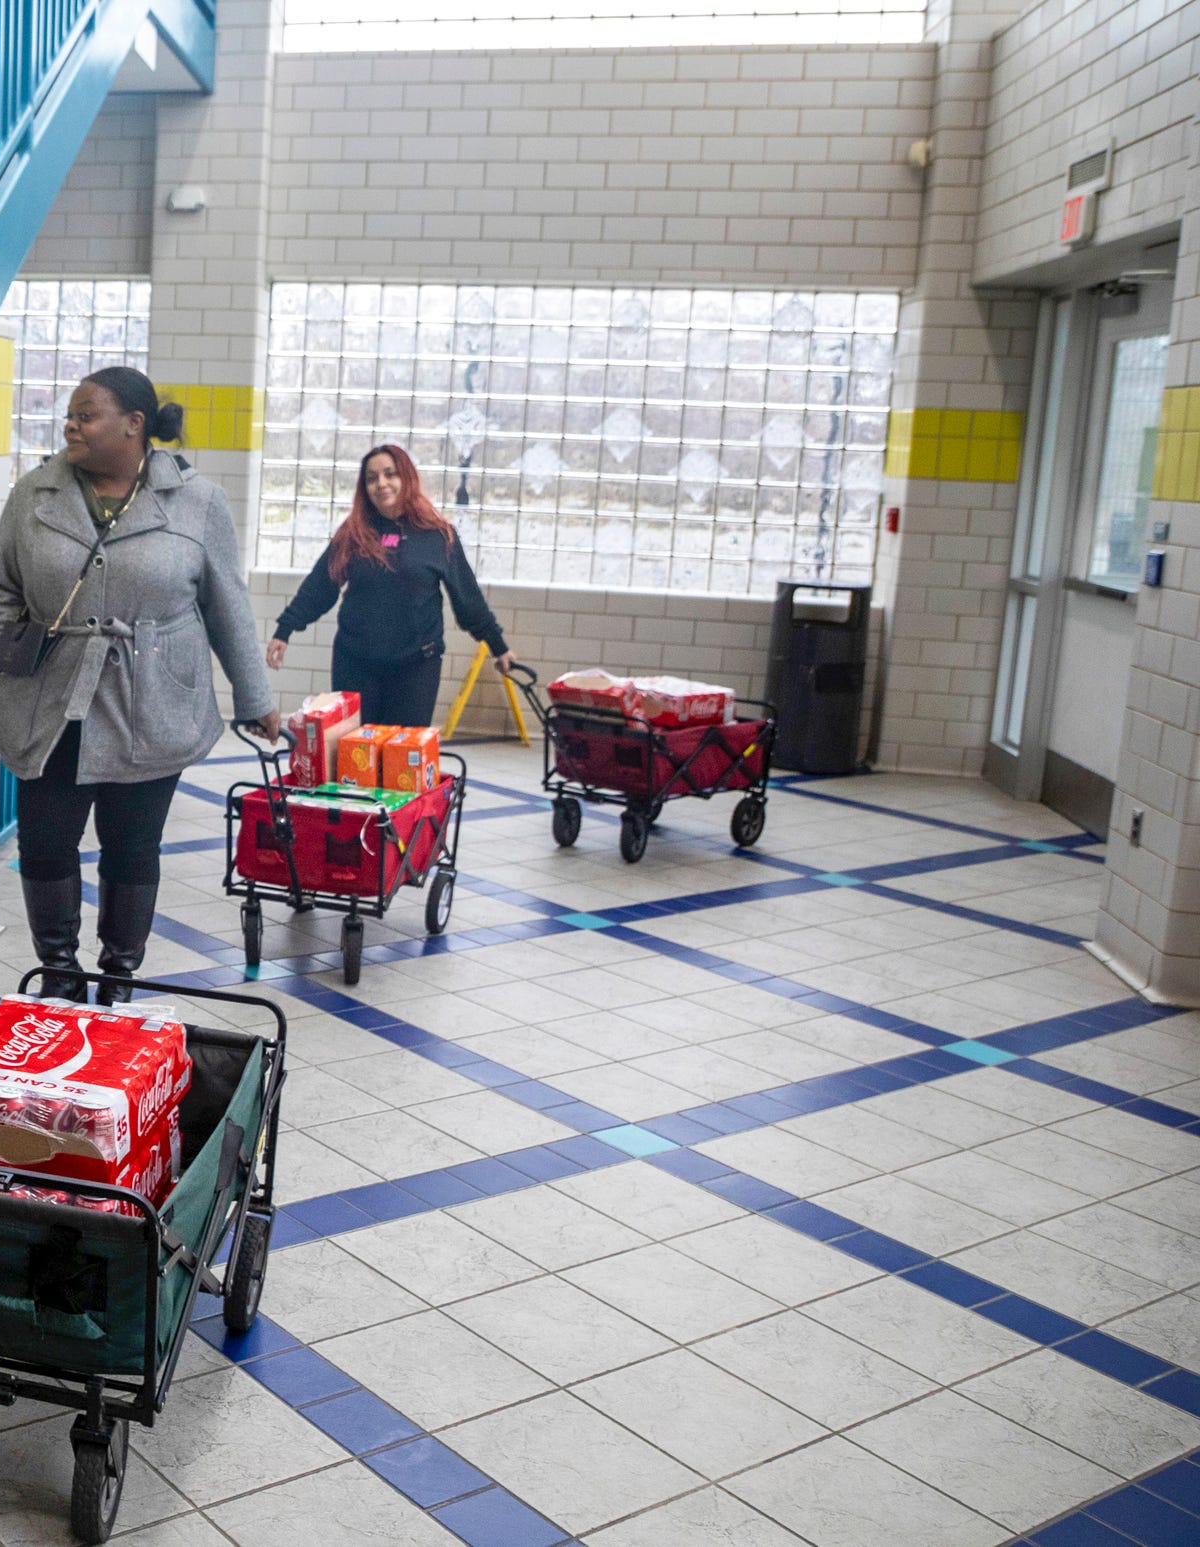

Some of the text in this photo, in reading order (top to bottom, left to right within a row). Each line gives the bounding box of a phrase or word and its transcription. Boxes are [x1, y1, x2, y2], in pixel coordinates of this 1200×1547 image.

[14, 1077, 57, 1090] CAN
[63, 1086, 89, 1096] 35
[116, 1114, 128, 1142] 35
